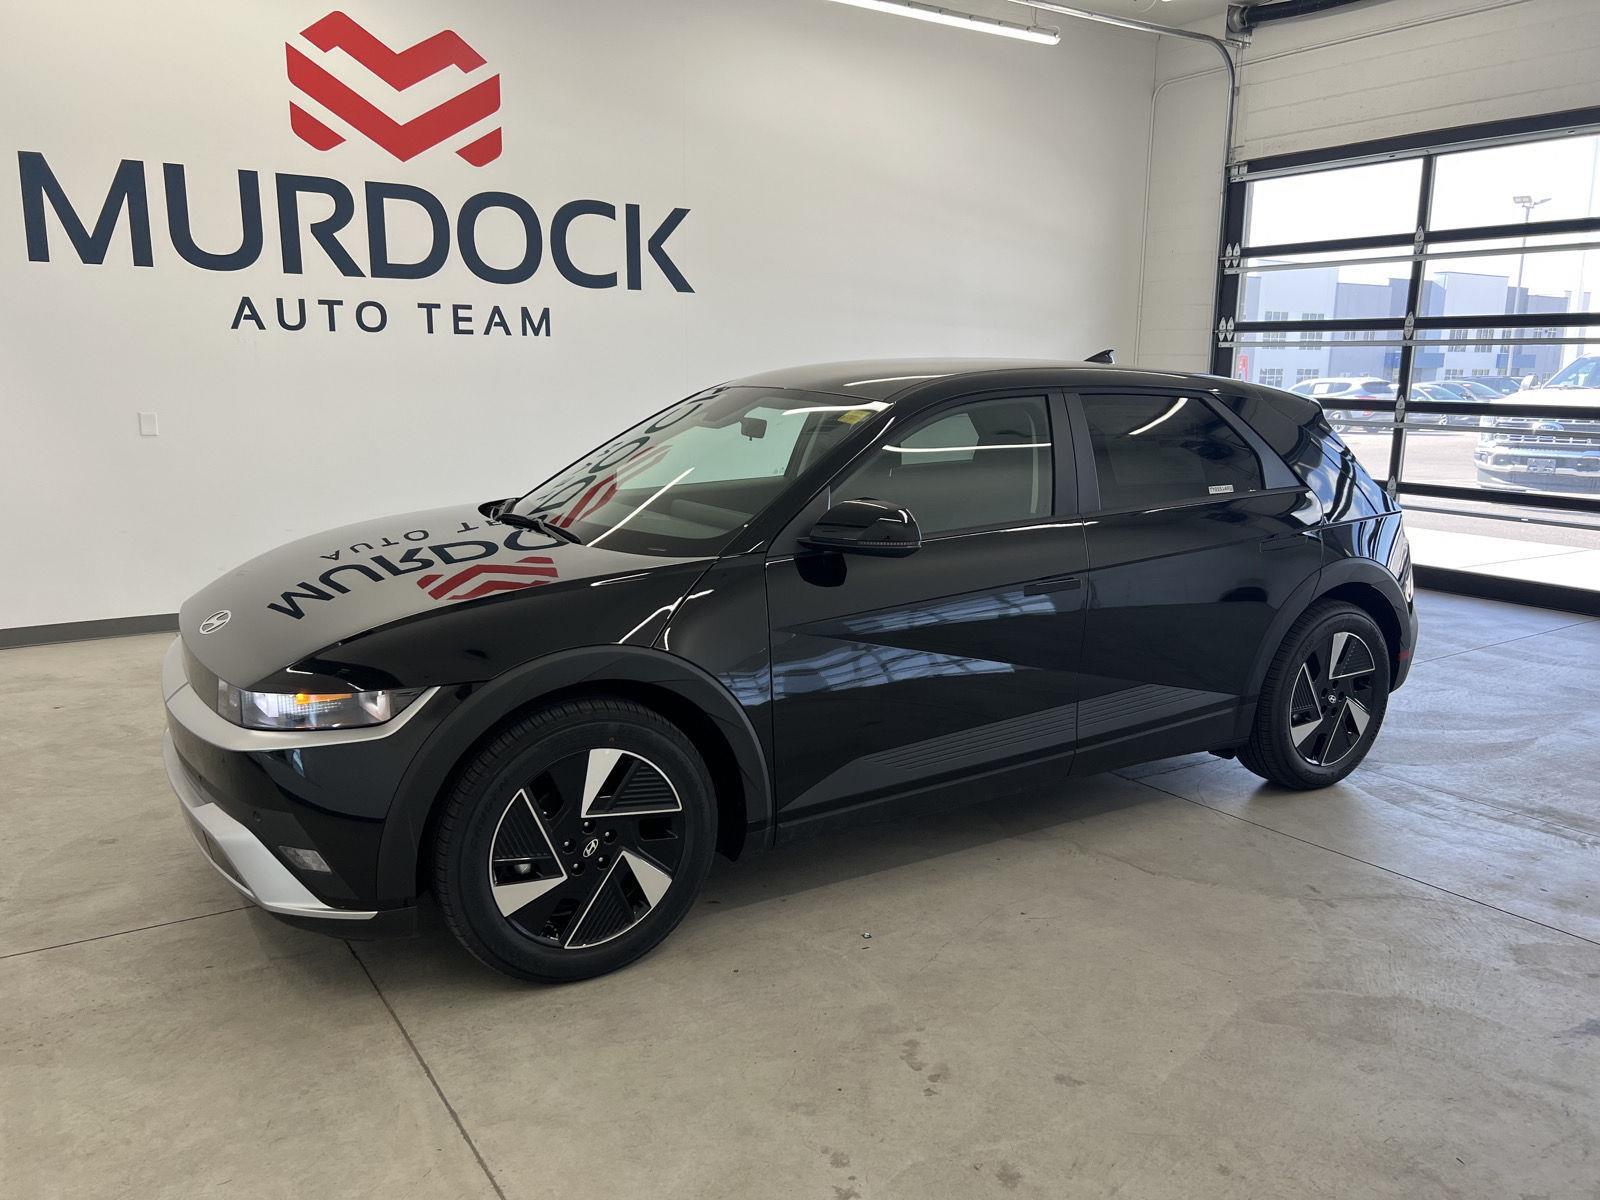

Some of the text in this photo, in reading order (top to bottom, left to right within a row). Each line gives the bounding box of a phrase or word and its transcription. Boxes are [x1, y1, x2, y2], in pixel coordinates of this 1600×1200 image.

[18, 150, 695, 294] MURDOCK
[231, 296, 551, 337] AUTO TEAM
